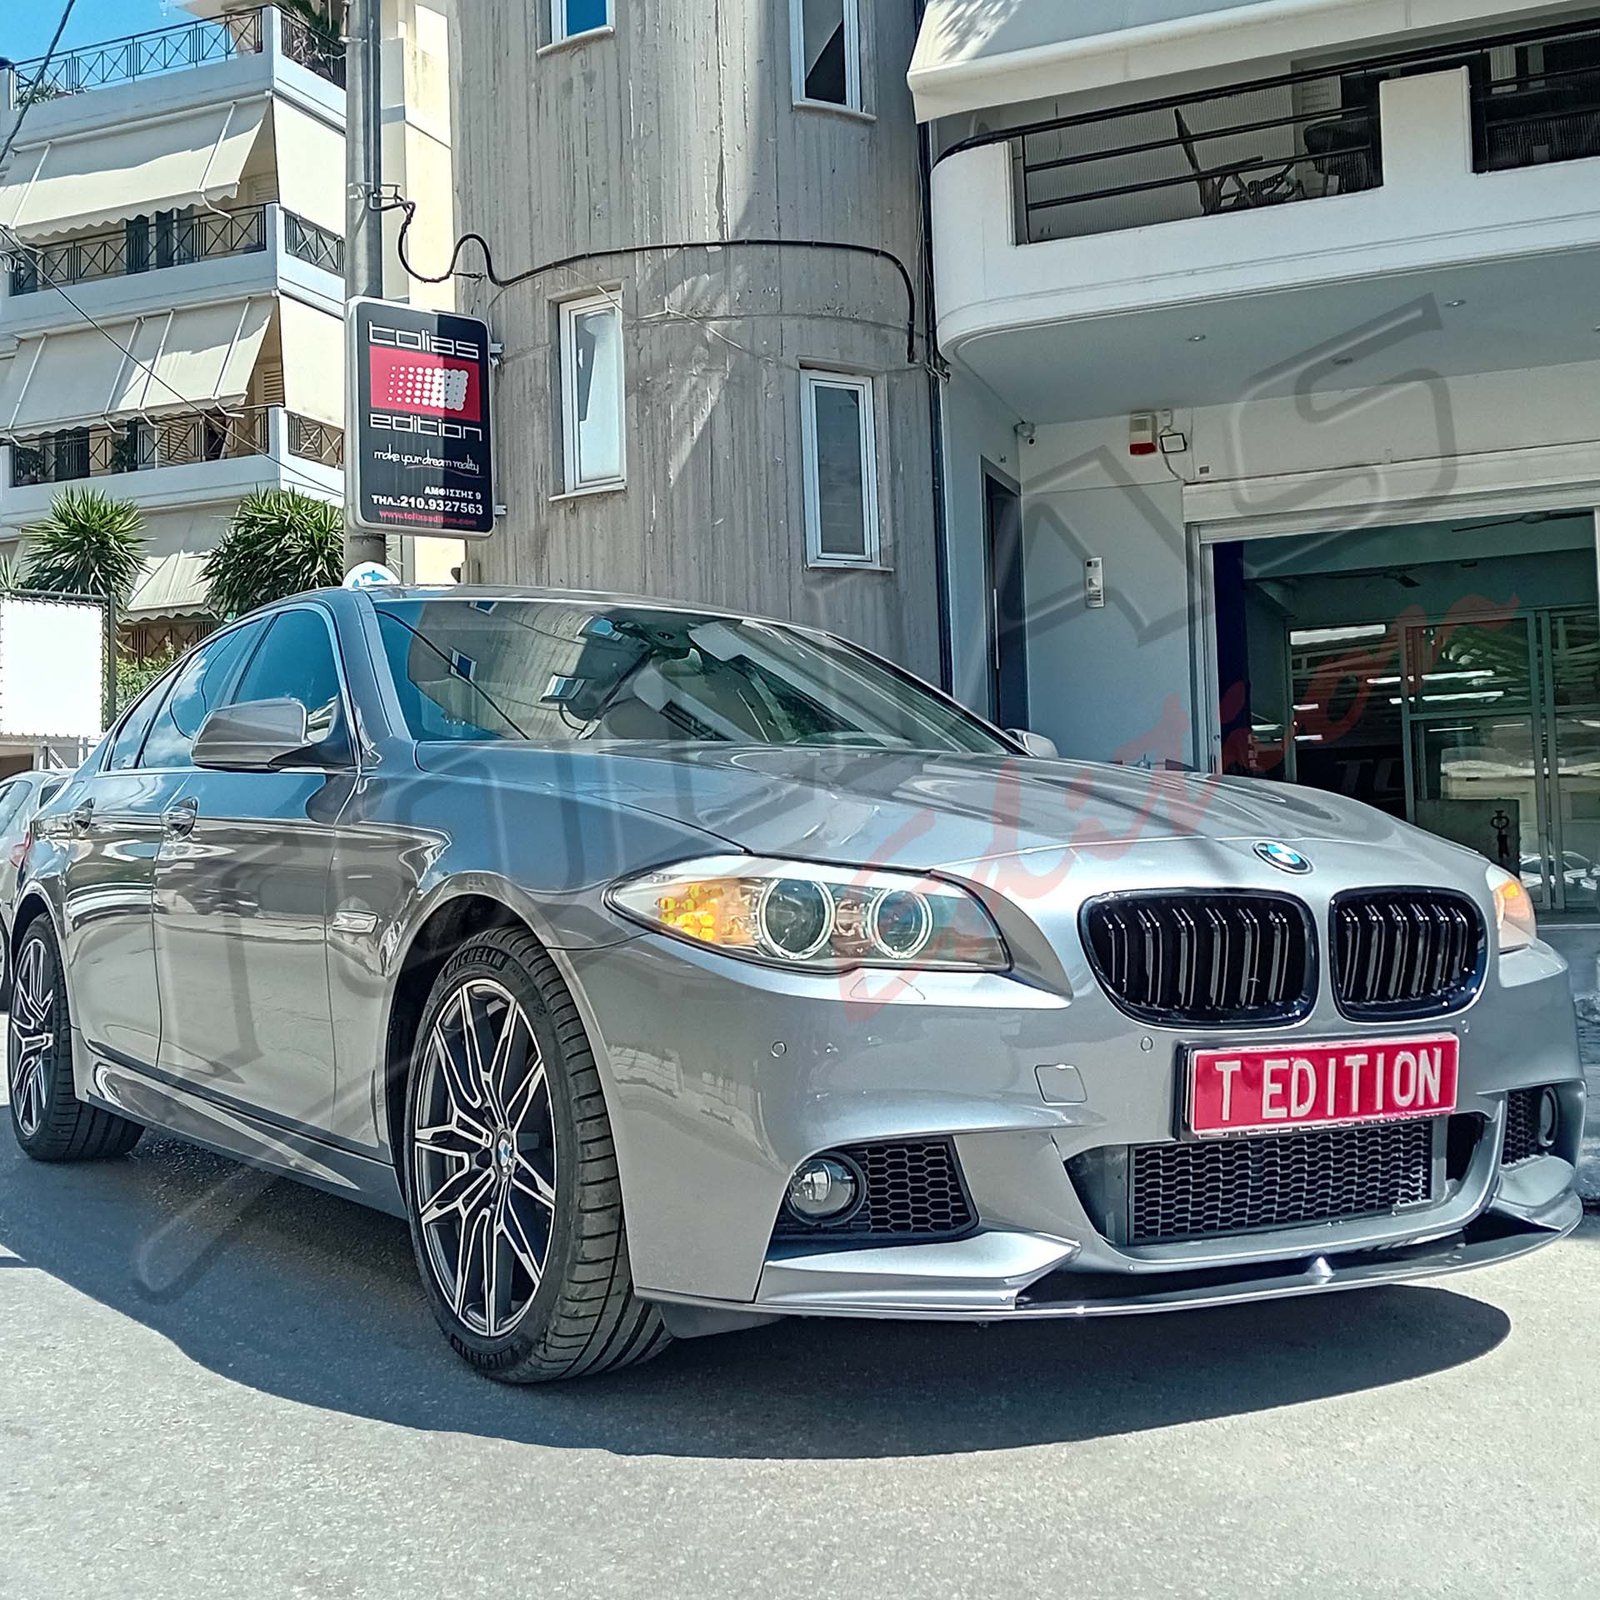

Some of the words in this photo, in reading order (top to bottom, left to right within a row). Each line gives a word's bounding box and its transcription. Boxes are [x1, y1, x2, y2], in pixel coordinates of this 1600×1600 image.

[368, 321, 479, 359] tolias
[369, 413, 482, 442] edition
[373, 444, 400, 462] make
[401, 454, 422, 466] your
[422, 449, 452, 467] dream
[475, 491, 482, 500] 9
[446, 947, 505, 976] MICHELIN
[1214, 1060, 1242, 1121] T
[1261, 1047, 1443, 1119] EDITION
